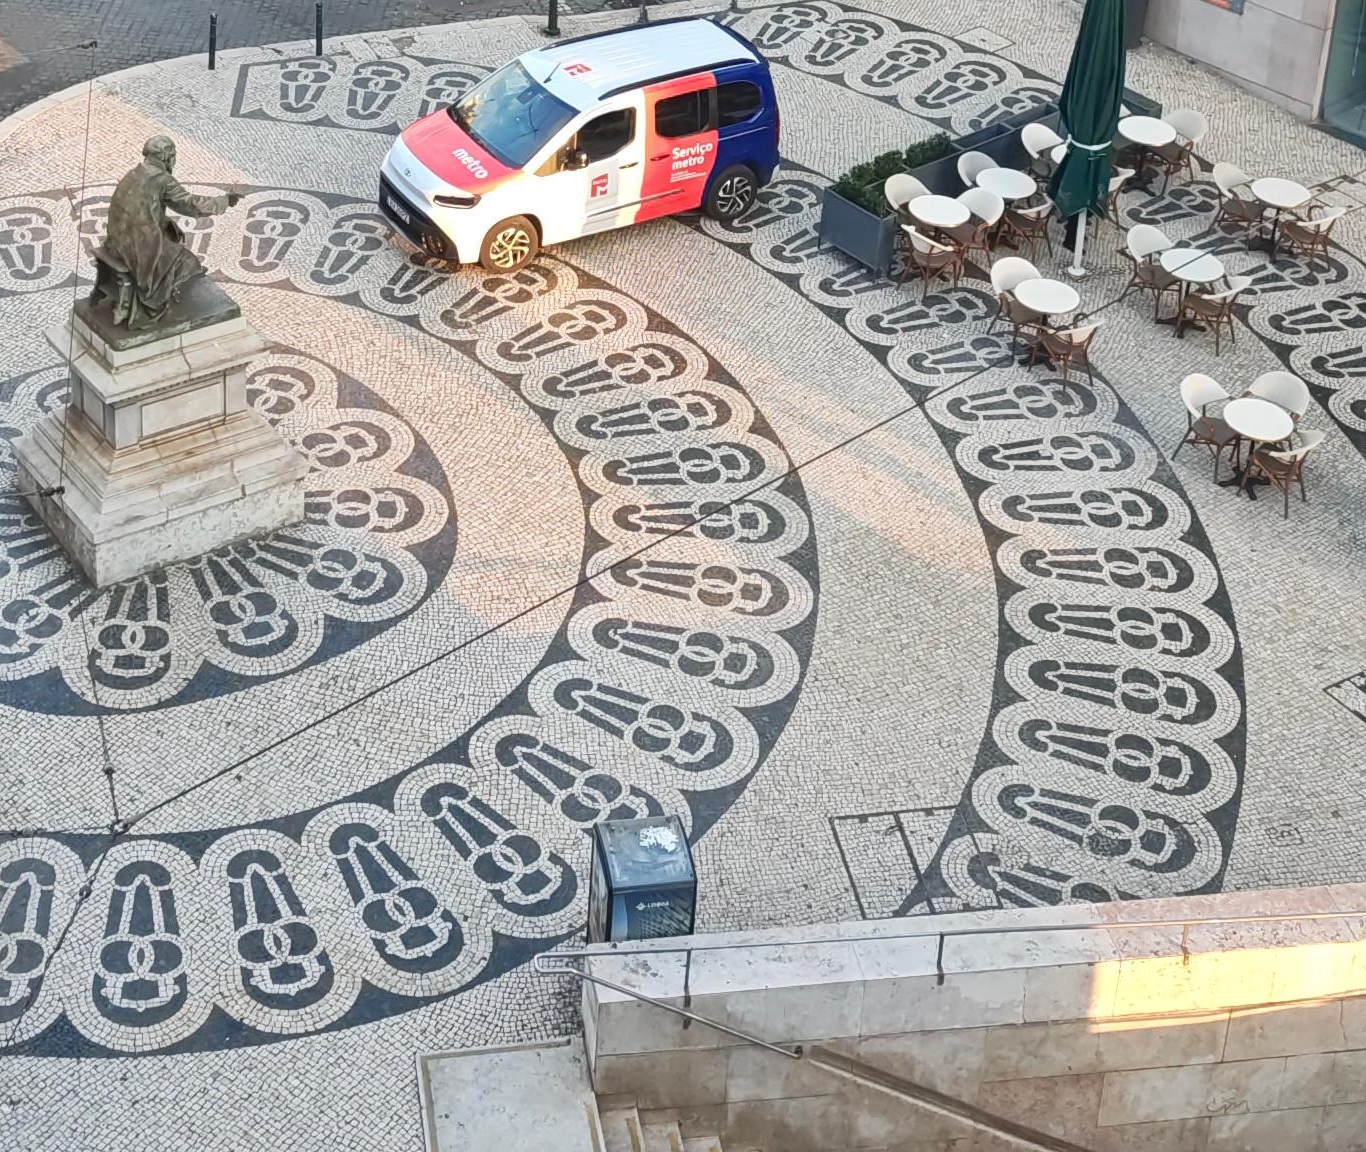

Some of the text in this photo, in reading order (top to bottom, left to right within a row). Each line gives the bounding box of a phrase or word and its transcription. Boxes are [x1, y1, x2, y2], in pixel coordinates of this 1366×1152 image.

[672, 142, 714, 161] Serviço
[450, 147, 489, 180] metro
[671, 155, 705, 171] metro
